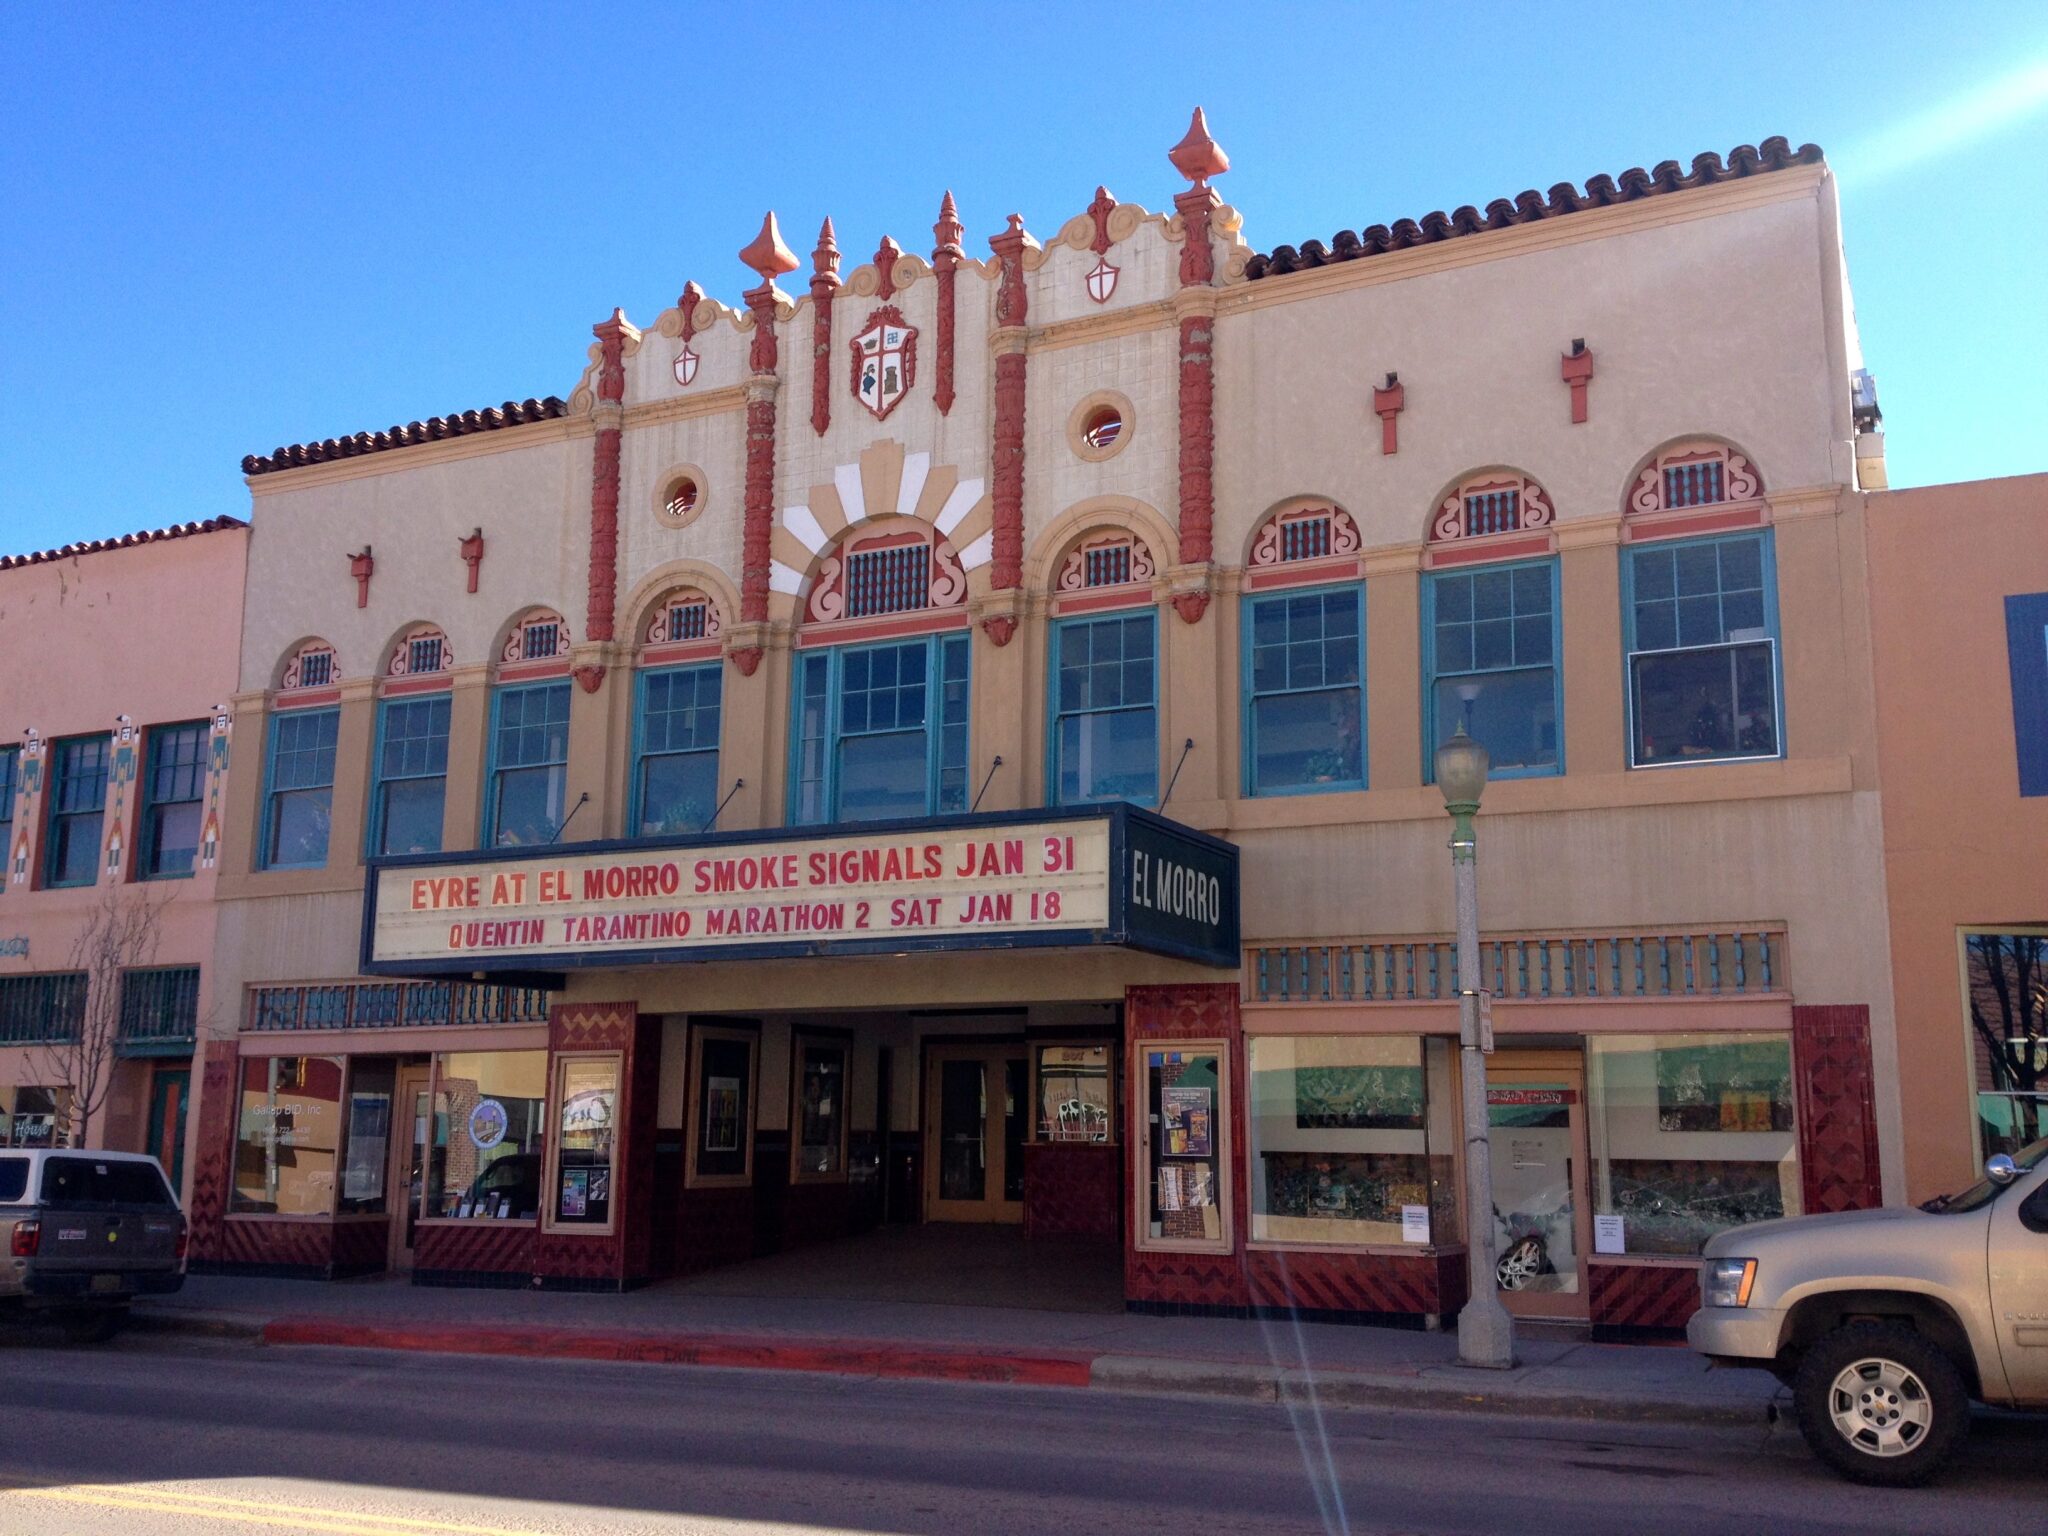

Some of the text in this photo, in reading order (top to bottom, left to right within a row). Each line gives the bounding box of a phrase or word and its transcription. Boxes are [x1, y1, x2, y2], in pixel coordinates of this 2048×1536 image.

[412, 836, 1074, 909] EYRE AT EL MORRO SMOKE SIGNALS JAN 31
[1133, 850, 1220, 926] EL MORRO
[449, 891, 1061, 949] QUENTIN TARANTINO MARATHON 2 SAT JAN 18
[15, 1120, 49, 1137] House
